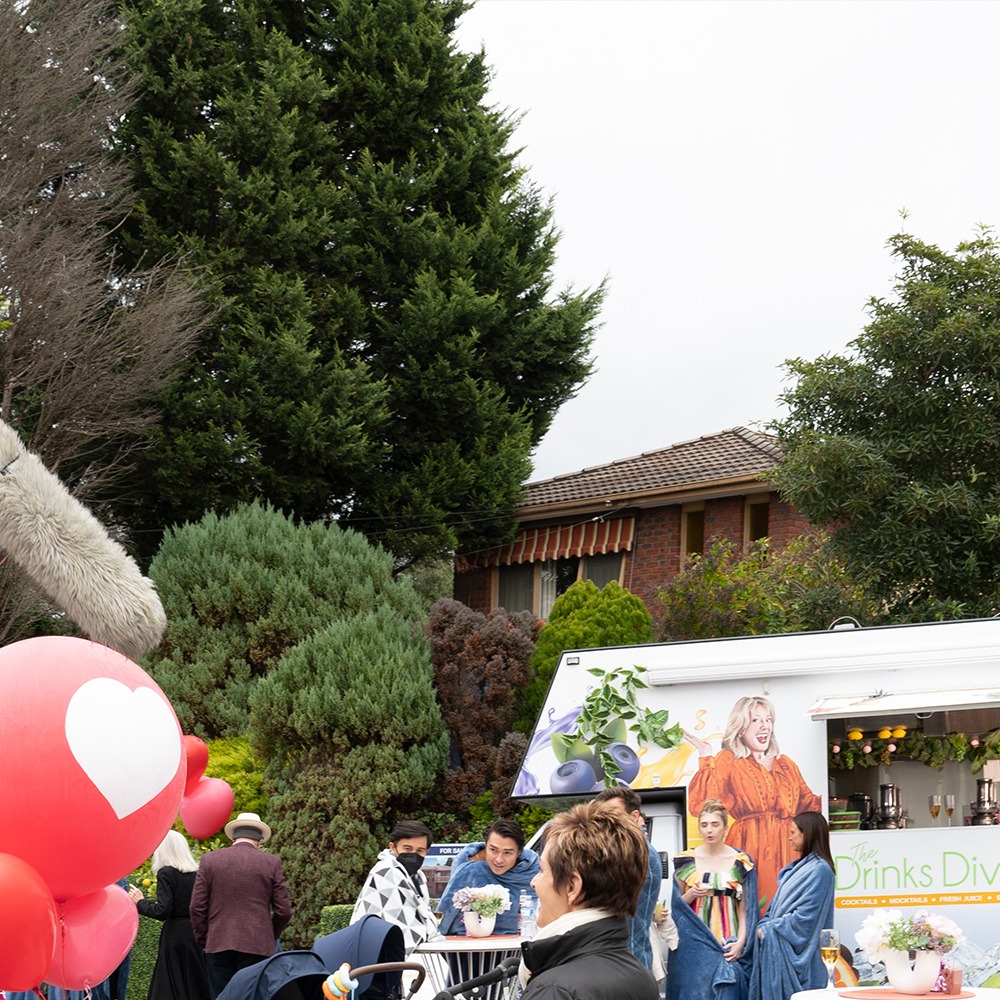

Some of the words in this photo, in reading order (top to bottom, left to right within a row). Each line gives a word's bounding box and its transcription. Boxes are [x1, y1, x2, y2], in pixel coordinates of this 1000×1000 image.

[851, 841, 879, 867] The
[835, 855, 933, 891] Drinks
[942, 851, 1000, 887] Div
[889, 897, 928, 905] MOCKTAILS
